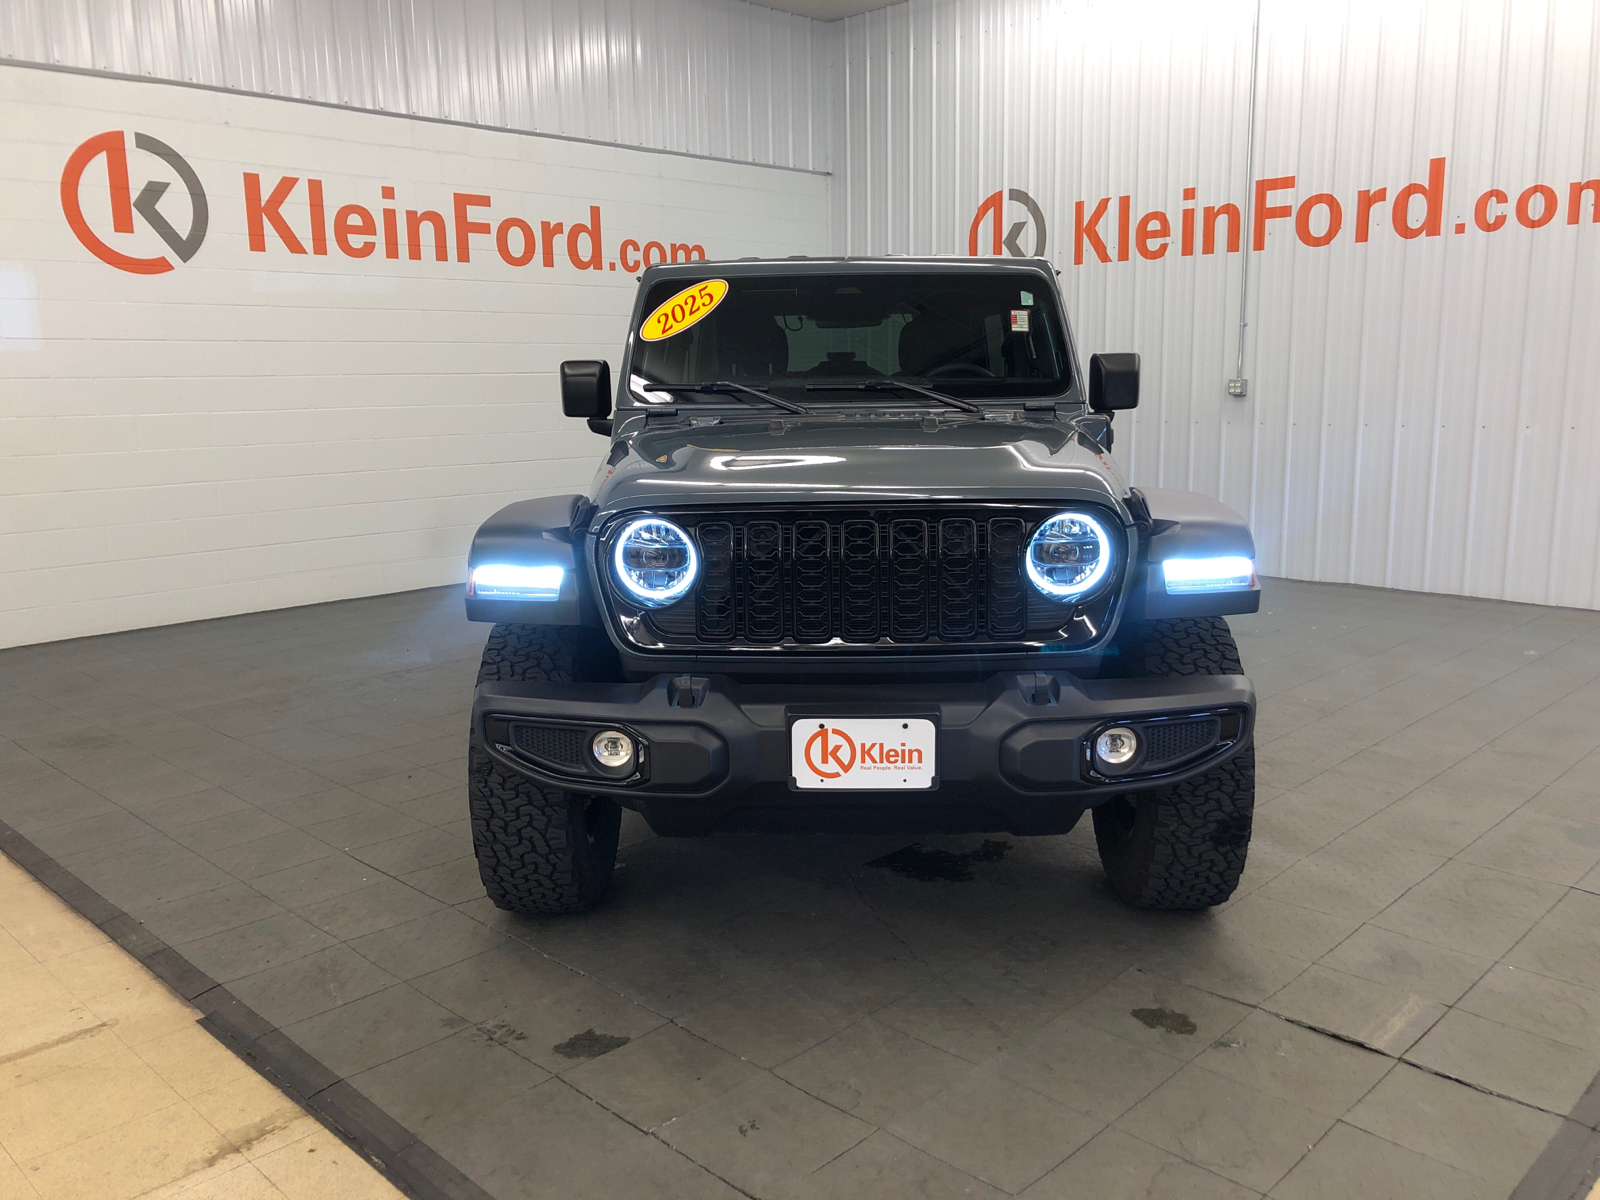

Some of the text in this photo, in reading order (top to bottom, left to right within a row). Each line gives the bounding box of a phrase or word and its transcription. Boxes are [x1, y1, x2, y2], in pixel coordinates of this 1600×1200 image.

[243, 173, 706, 274] KleinFord.com
[657, 285, 714, 335] 2025
[860, 742, 923, 765] Klein
